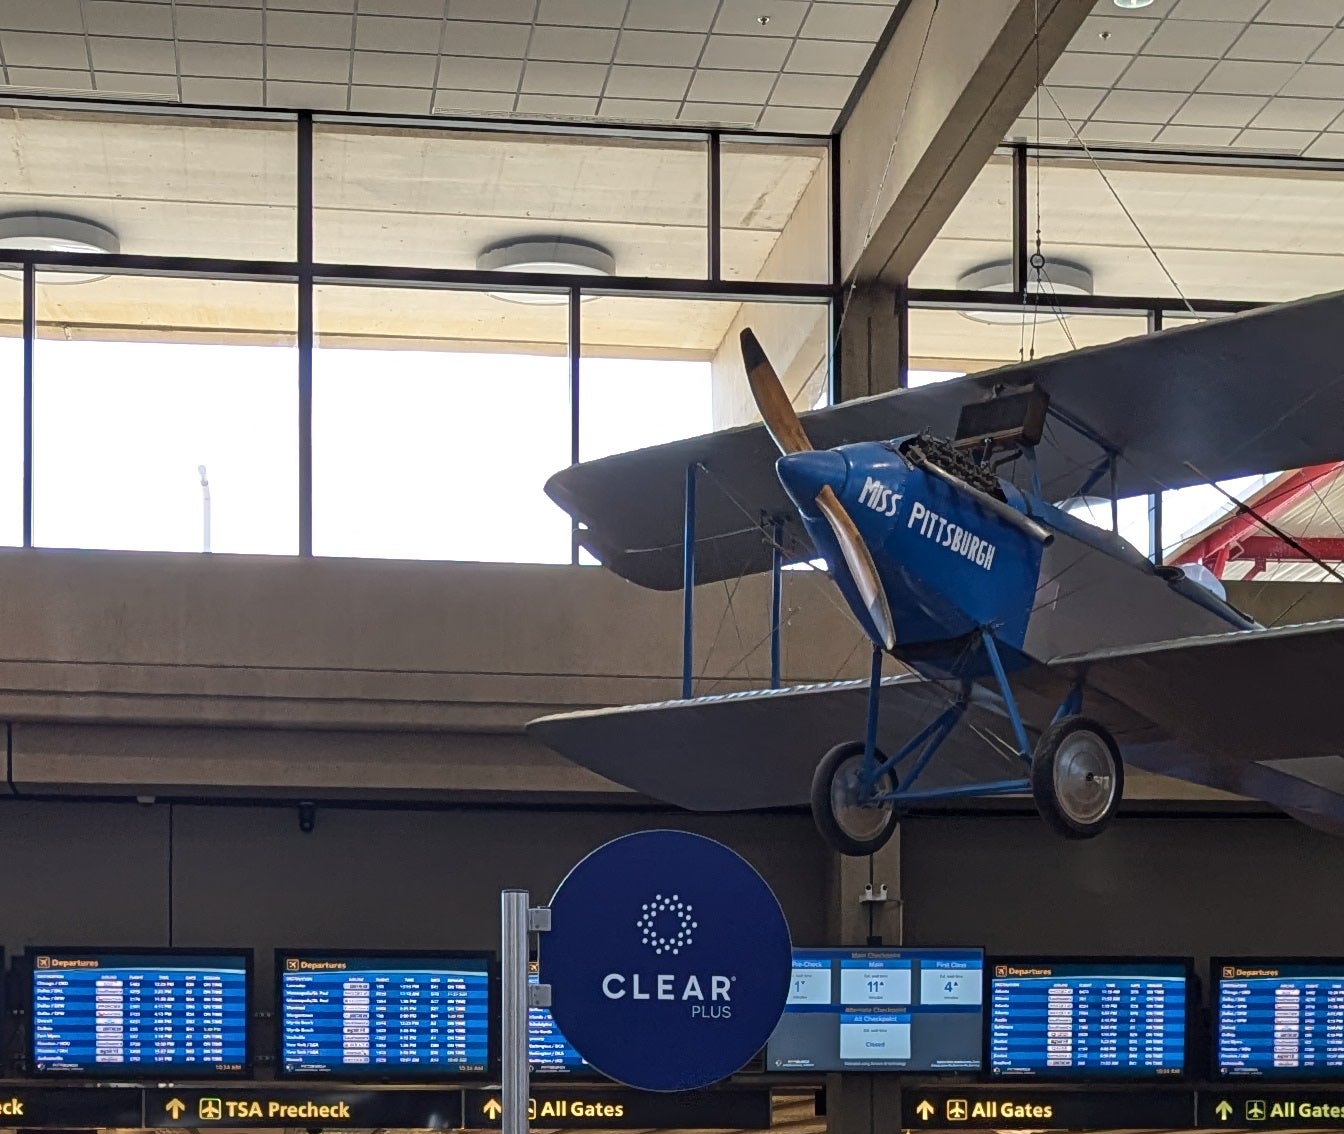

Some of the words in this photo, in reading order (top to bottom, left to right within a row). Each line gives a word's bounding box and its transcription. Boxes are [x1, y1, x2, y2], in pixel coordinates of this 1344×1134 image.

[858, 476, 903, 517] MISS
[907, 501, 995, 570] PITTSBURGH
[51, 959, 99, 968] Departures
[300, 960, 347, 970] Departures
[1008, 967, 1052, 976] Departures
[1236, 968, 1279, 977] Departures
[602, 973, 731, 1001] CLEAR
[794, 981, 800, 992] 1
[867, 981, 879, 992] 11
[944, 981, 953, 992] 4
[691, 1005, 732, 1018] PLUS
[225, 1101, 263, 1118] TSA
[268, 1101, 351, 1119] Precheck
[540, 1101, 568, 1117] All
[571, 1101, 624, 1118] Gates
[971, 1102, 997, 1118] All
[1000, 1102, 1053, 1119] Gates
[1270, 1102, 1295, 1118] All
